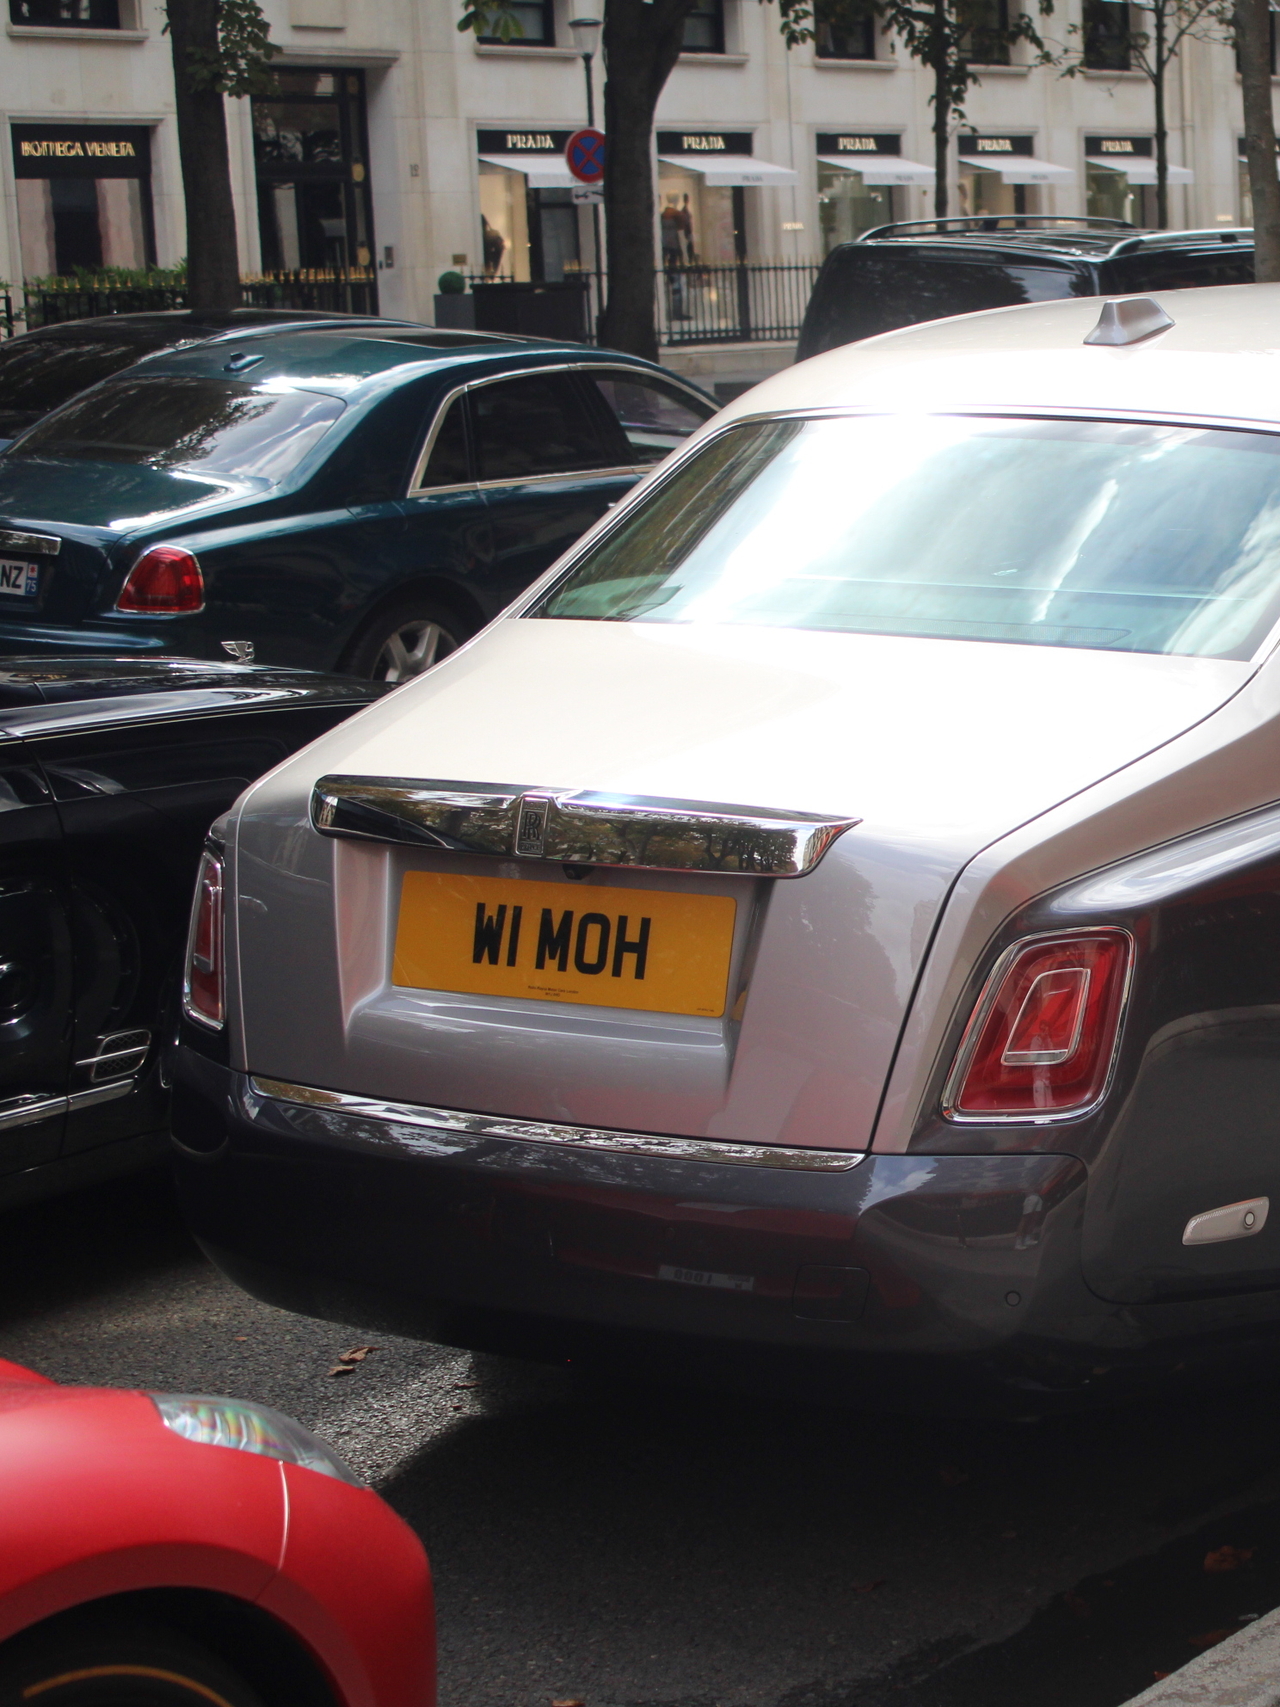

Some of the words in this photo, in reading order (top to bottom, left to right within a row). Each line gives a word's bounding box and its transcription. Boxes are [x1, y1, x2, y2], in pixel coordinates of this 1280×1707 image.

[21, 141, 84, 156] BOTTEGA
[85, 141, 136, 156] VENETA
[506, 134, 555, 149] PRADA
[682, 135, 726, 150] PRADA
[837, 137, 878, 150] PRADA
[977, 138, 1013, 151] PRADA
[1100, 140, 1134, 152] PRADA
[0, 564, 24, 590] NZ
[26, 580, 37, 592] 75
[535, 908, 651, 980] MOH
